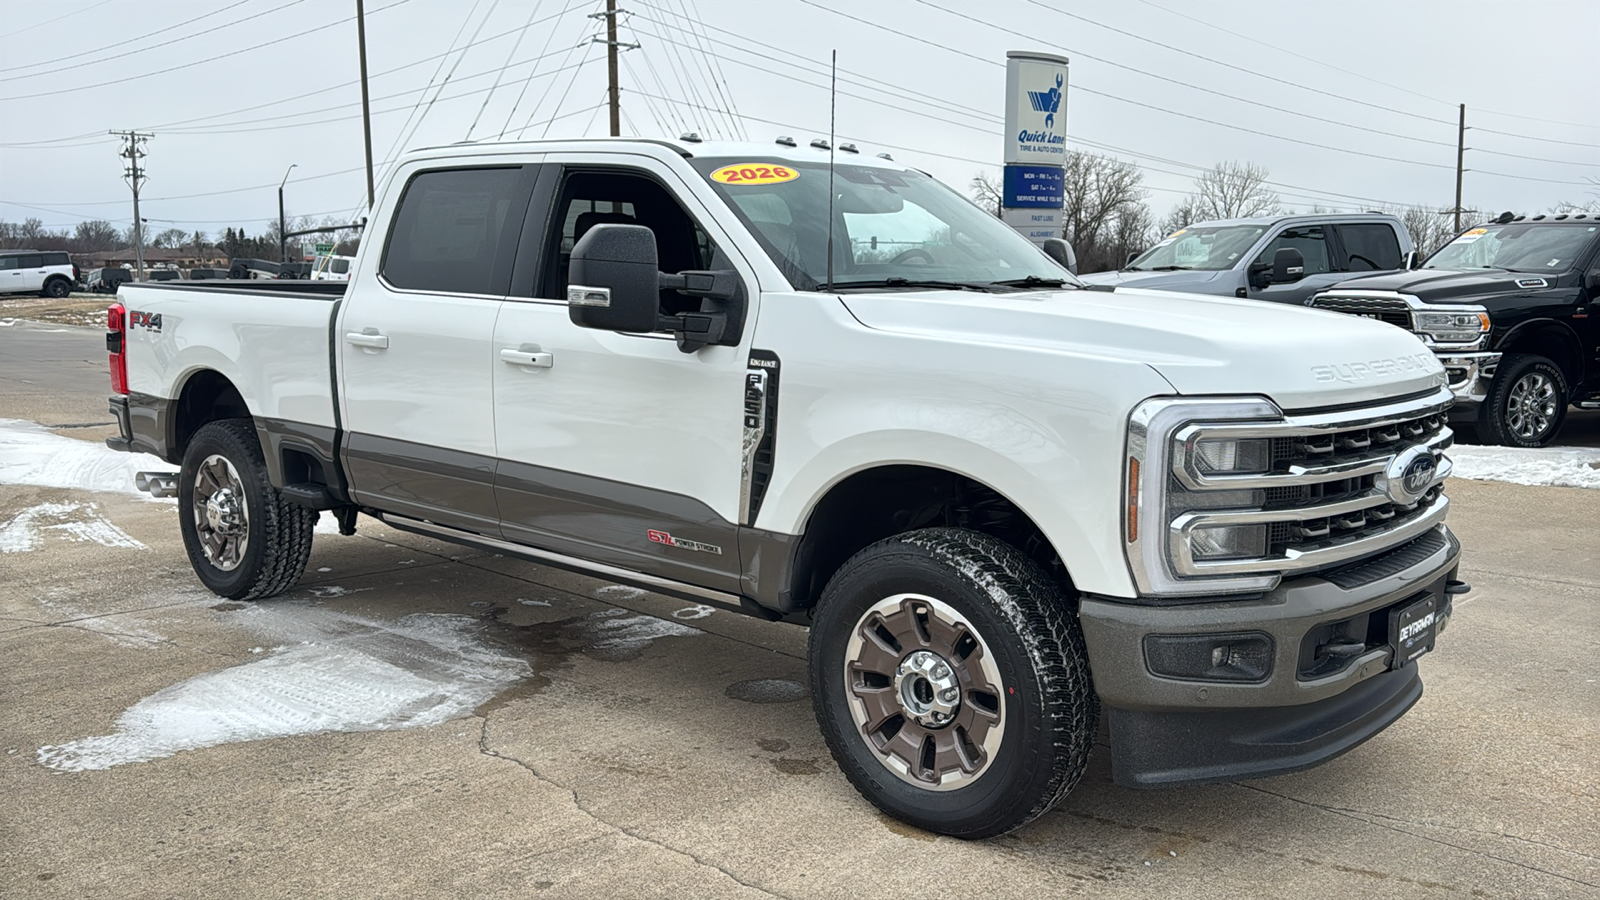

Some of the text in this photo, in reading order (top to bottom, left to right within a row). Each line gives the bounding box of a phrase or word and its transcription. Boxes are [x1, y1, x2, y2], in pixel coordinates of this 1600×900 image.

[1018, 130, 1064, 144] Quick Lane
[722, 167, 790, 182] 2026
[130, 310, 163, 330] FX4
[750, 358, 777, 369] KING RANCH
[1310, 359, 1402, 385] SUPER
[1410, 461, 1434, 489] Ford
[675, 538, 720, 553] POWER STROKE
[1399, 611, 1435, 643] DEYARMAN
